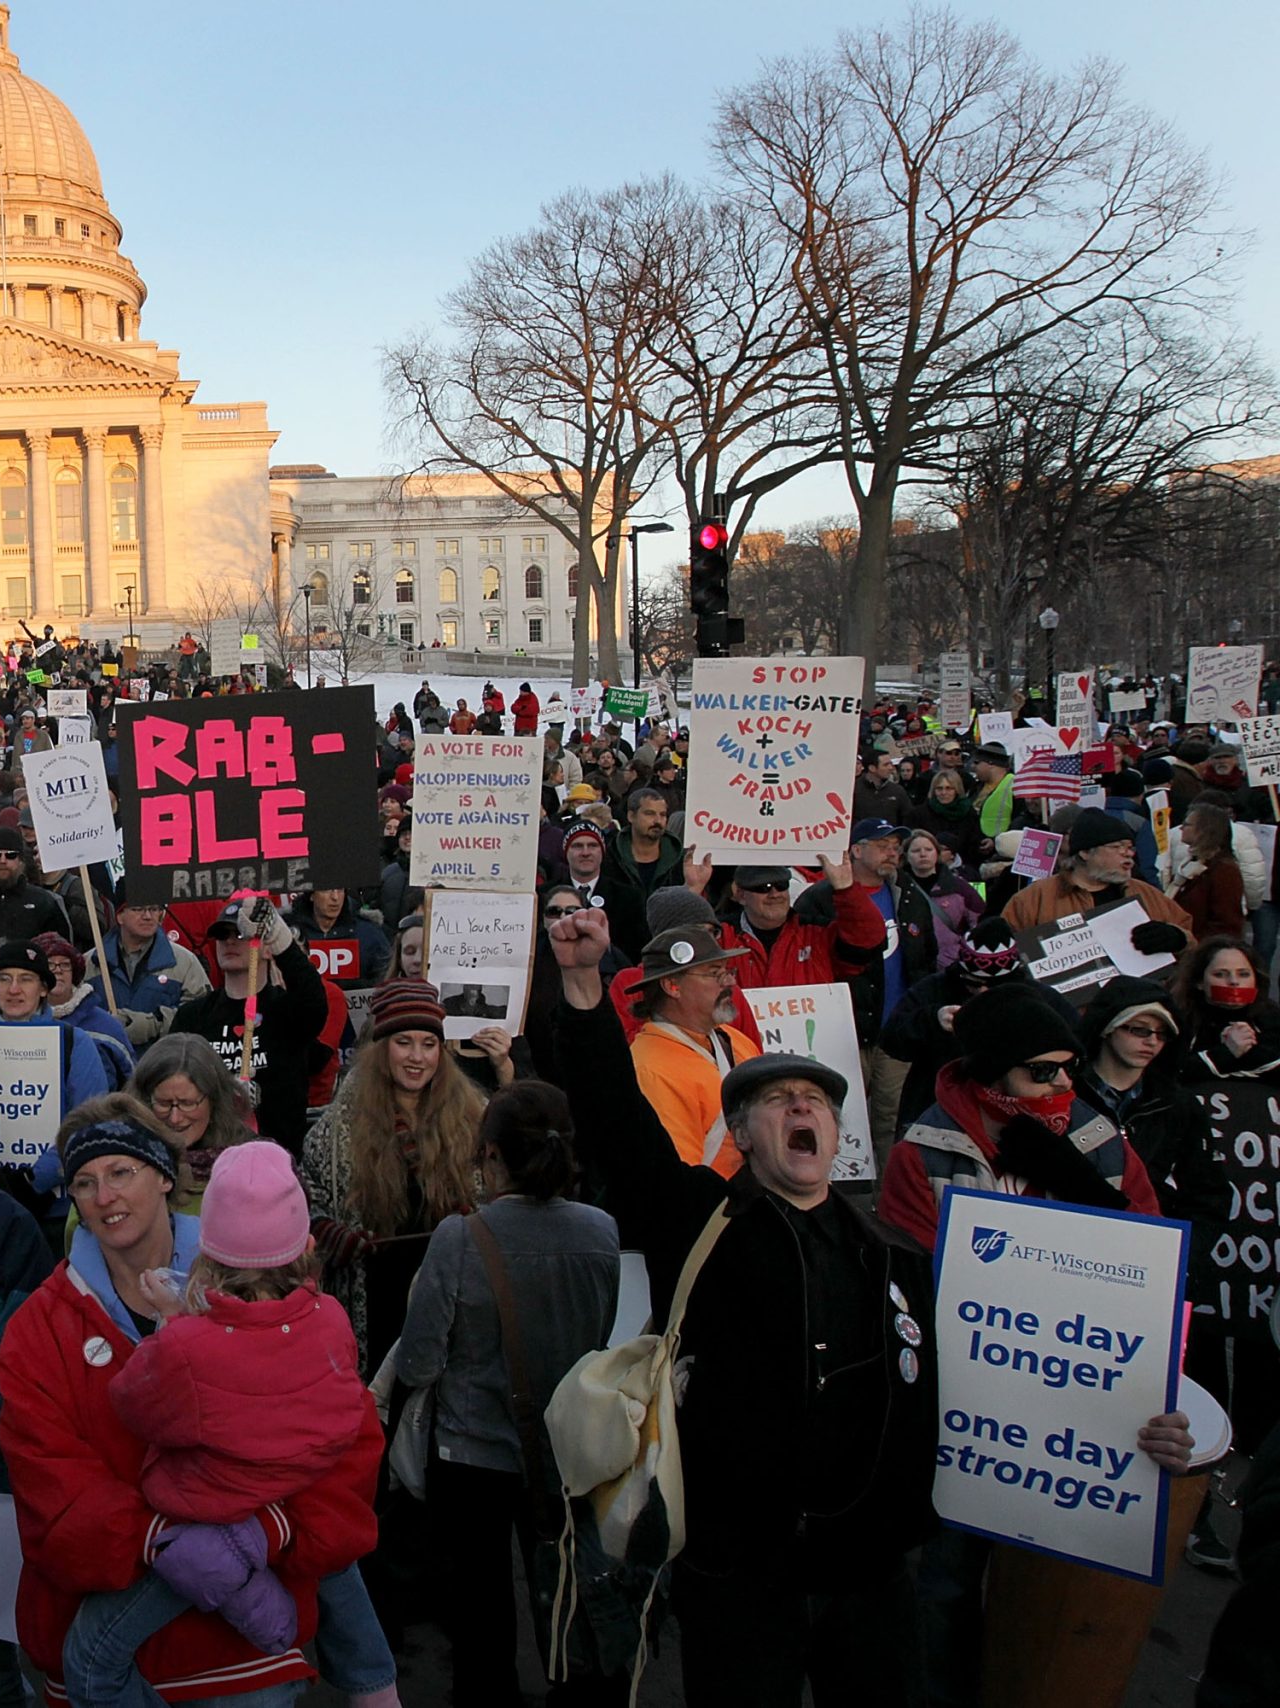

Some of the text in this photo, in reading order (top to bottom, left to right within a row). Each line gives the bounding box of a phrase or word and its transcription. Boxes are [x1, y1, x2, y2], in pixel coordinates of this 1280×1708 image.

[752, 666, 827, 684] STOP
[623, 692, 645, 701] About
[694, 693, 862, 714] WALKER-GATE!
[737, 716, 812, 738] KOCH
[66, 734, 84, 743] MTI
[423, 742, 524, 757] A VOTE FOR
[716, 733, 814, 770] WALKER
[45, 775, 89, 798] MTI
[415, 772, 531, 787] KLOPPENBURG
[729, 772, 812, 802] FRAUD
[484, 794, 497, 808] A
[140, 788, 310, 866] BLE
[415, 812, 454, 826] VOTE
[48, 825, 104, 847] Solidarity!
[439, 836, 501, 850] WALKER
[172, 858, 314, 899] RABBLE
[490, 863, 501, 876] 5
[1058, 916, 1083, 930] Vote
[433, 944, 456, 956] ARE
[1048, 939, 1064, 955] Jo
[310, 948, 354, 976] OP
[1058, 969, 1118, 992] Supreme Court
[753, 997, 816, 1021] LKER
[222, 1024, 228, 1038] I
[10, 1080, 50, 1101] day
[1010, 1245, 1146, 1281] AFT-Wisconsin
[1059, 1266, 1083, 1277] Union
[1084, 1271, 1094, 1280] of
[1094, 1271, 1146, 1289] Professionals
[957, 1298, 1145, 1364] one day
[968, 1330, 1123, 1392] longer
[943, 1407, 1135, 1481] one day
[936, 1442, 1143, 1516] stronger
